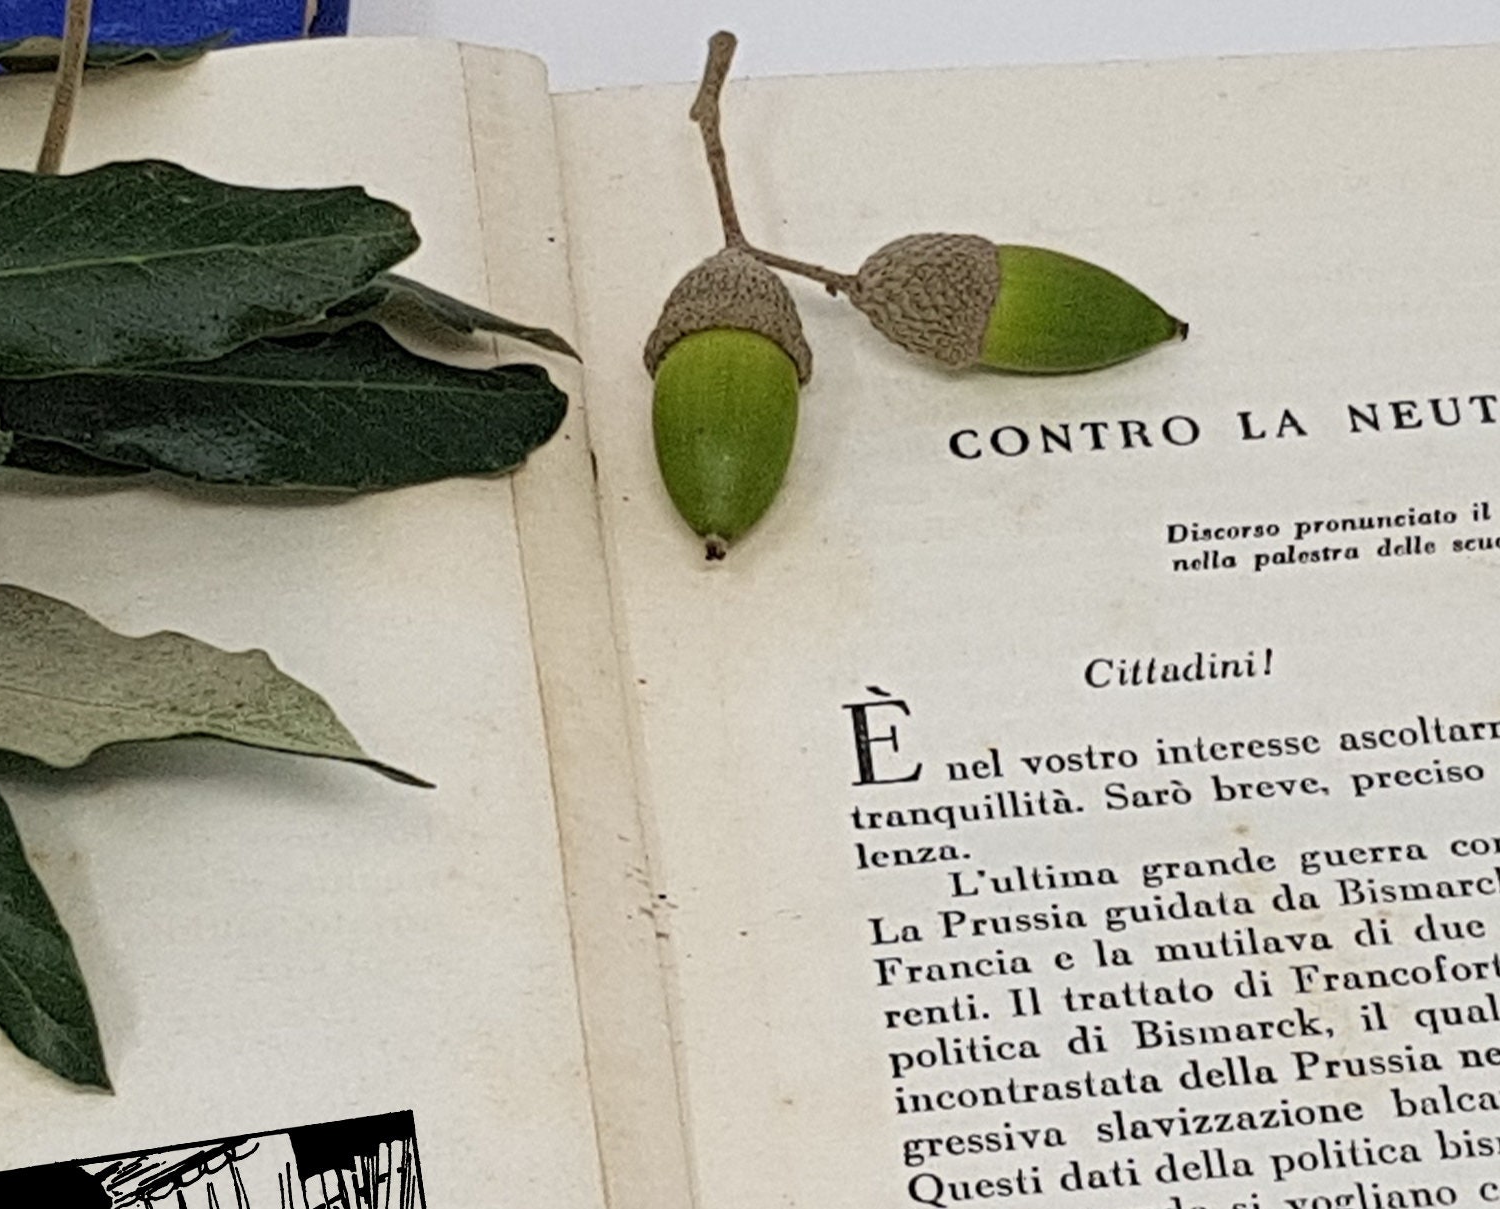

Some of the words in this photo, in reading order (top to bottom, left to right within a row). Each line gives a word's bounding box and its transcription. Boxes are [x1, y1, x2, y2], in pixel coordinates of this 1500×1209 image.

[948, 415, 1201, 460] CONTRO
[1236, 408, 1308, 441] LA
[1347, 394, 1498, 434] NEUT
[1166, 519, 1281, 545] Discorso
[1293, 507, 1458, 542] pronunciato
[1472, 501, 1492, 523] il
[1171, 549, 1238, 572] nella
[1253, 544, 1360, 573] palestra
[1376, 535, 1436, 558] delle
[1084, 647, 1273, 689] Cittadini!
[841, 685, 923, 787] È
[945, 747, 1005, 782] nel
[1019, 744, 1139, 776] vostro
[1156, 734, 1321, 766] interesse
[850, 788, 1085, 831] tranquillità.
[1104, 779, 1193, 811] Sarò
[1210, 774, 1330, 802] breve,
[1350, 758, 1485, 798] preciso
[854, 842, 971, 870] lenza.
[947, 864, 1120, 898] L'ultima
[1142, 846, 1277, 889] grande
[1300, 843, 1429, 876] guerra
[867, 916, 924, 946] La
[937, 903, 1088, 939] Prussia
[1104, 890, 1256, 933] guidata
[1271, 882, 1321, 913] da
[872, 948, 1033, 987] Francia
[1054, 951, 1075, 972] e
[1092, 938, 1134, 968] la
[1154, 926, 1334, 963] mutilava
[1354, 917, 1394, 948] di
[1414, 912, 1486, 943] due
[883, 993, 990, 1029] renti.
[1007, 986, 1042, 1018] Il
[1063, 977, 1214, 1013] trattato
[1234, 968, 1273, 1000] di
[888, 1034, 1042, 1080] politica
[1067, 1024, 1109, 1056] di
[1131, 1006, 1335, 1050] Bismarck,
[1360, 1001, 1389, 1033] il
[1414, 992, 1500, 1035] qual
[894, 1067, 1164, 1115] incontrastata
[1178, 1055, 1279, 1091] della
[1290, 1044, 1444, 1082] Prussia
[1457, 1046, 1500, 1069] ne
[902, 1121, 1068, 1168] gressiva
[1096, 1098, 1364, 1144] slavizzazione
[1389, 1083, 1500, 1118] balca
[907, 1165, 1044, 1209] Questi
[1059, 1157, 1142, 1193] dati
[1154, 1147, 1255, 1185] della
[1269, 1137, 1423, 1183] politica
[1433, 1128, 1500, 1161] bis
